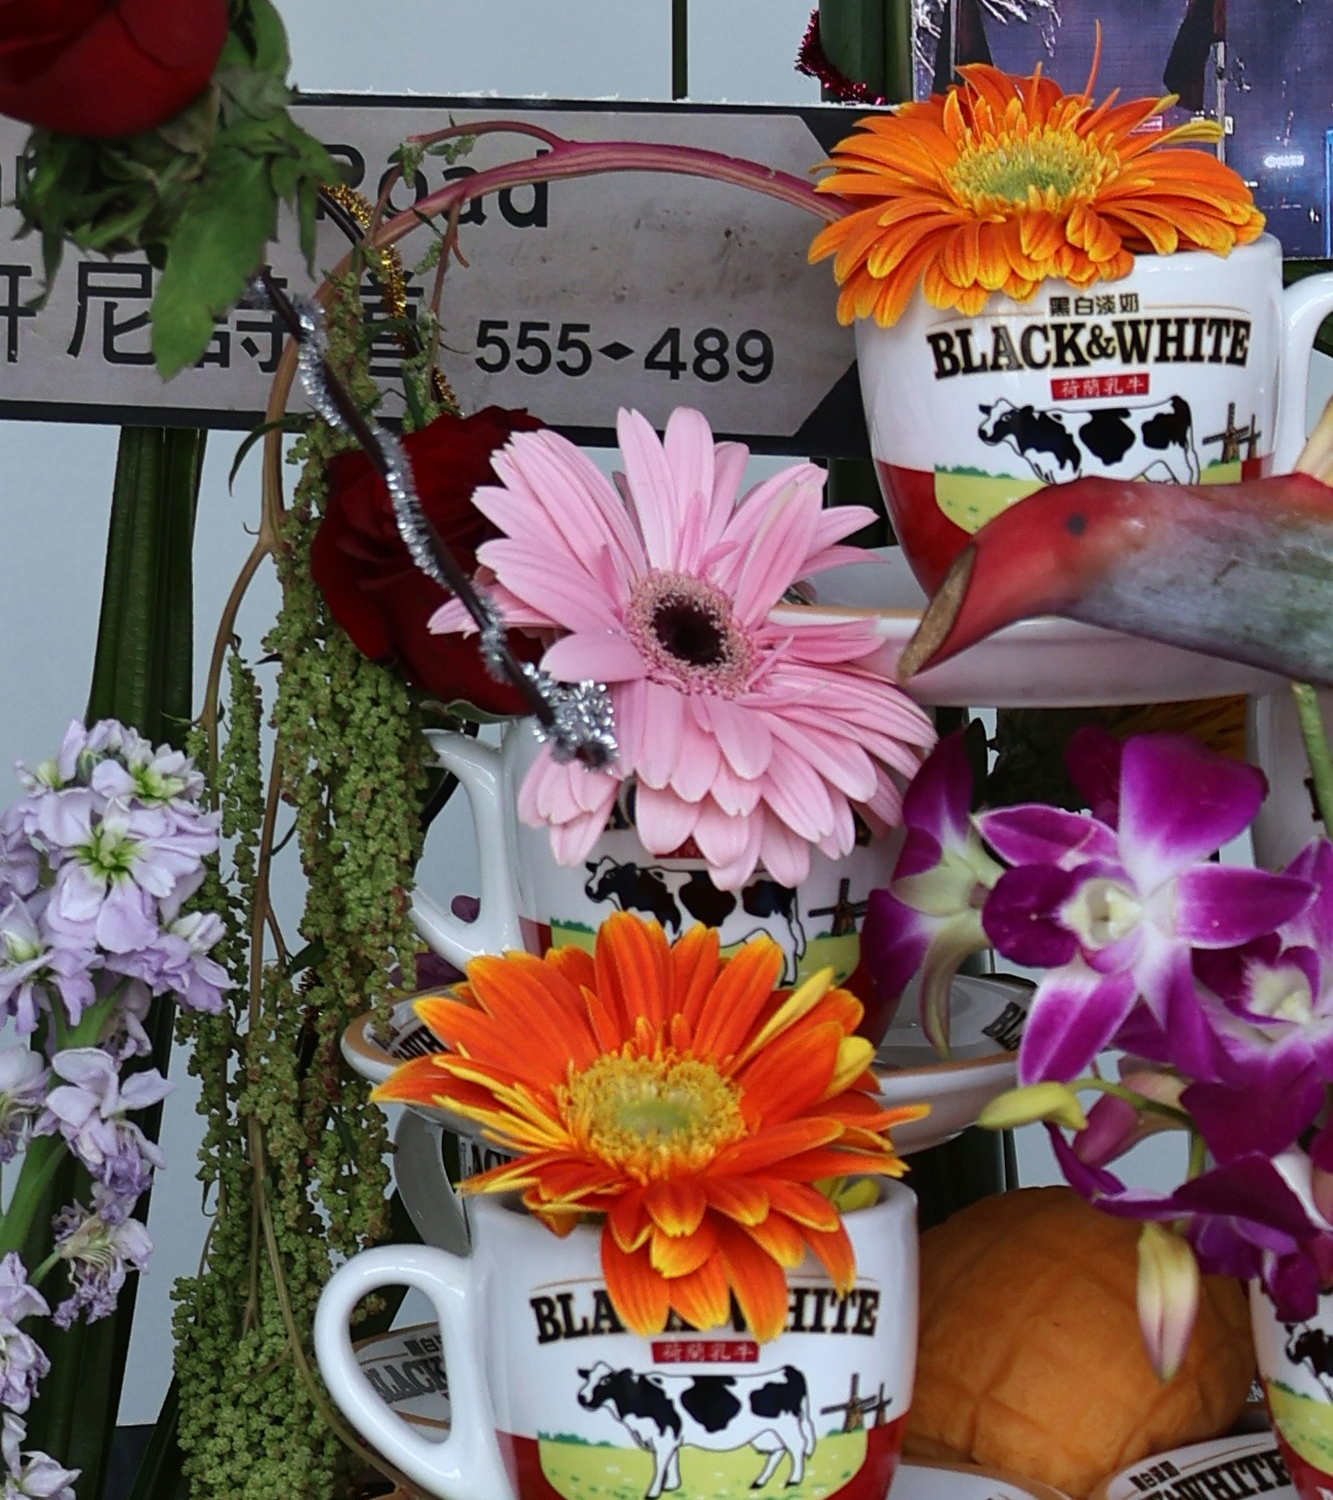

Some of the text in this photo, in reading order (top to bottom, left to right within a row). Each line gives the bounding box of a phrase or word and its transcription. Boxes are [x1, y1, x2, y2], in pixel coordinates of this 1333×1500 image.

[1049, 292, 1140, 318] 黑白淡奶
[926, 317, 1252, 381] BLACK&WHITE
